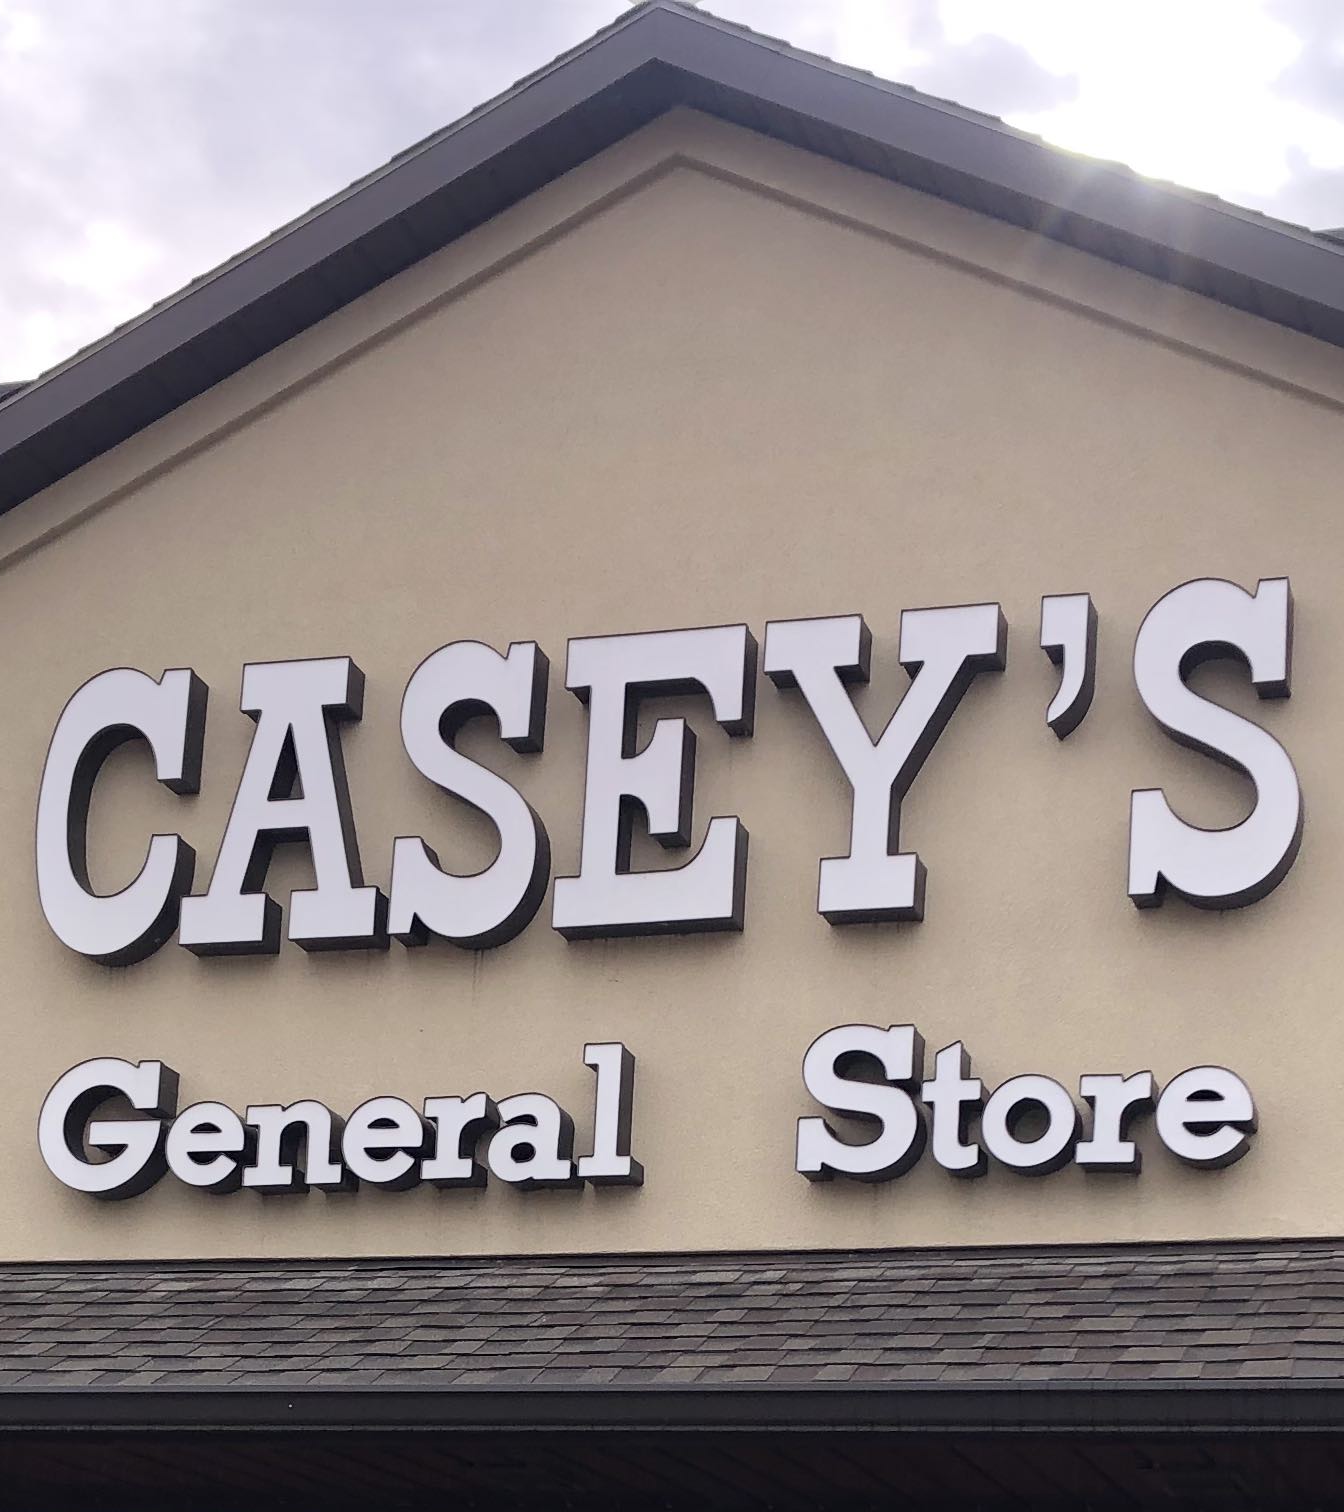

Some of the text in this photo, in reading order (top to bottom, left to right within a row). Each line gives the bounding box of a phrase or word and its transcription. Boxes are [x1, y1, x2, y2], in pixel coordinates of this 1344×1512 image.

[35, 576, 1303, 966] CASEY'S
[38, 1023, 1257, 1199] General Store
